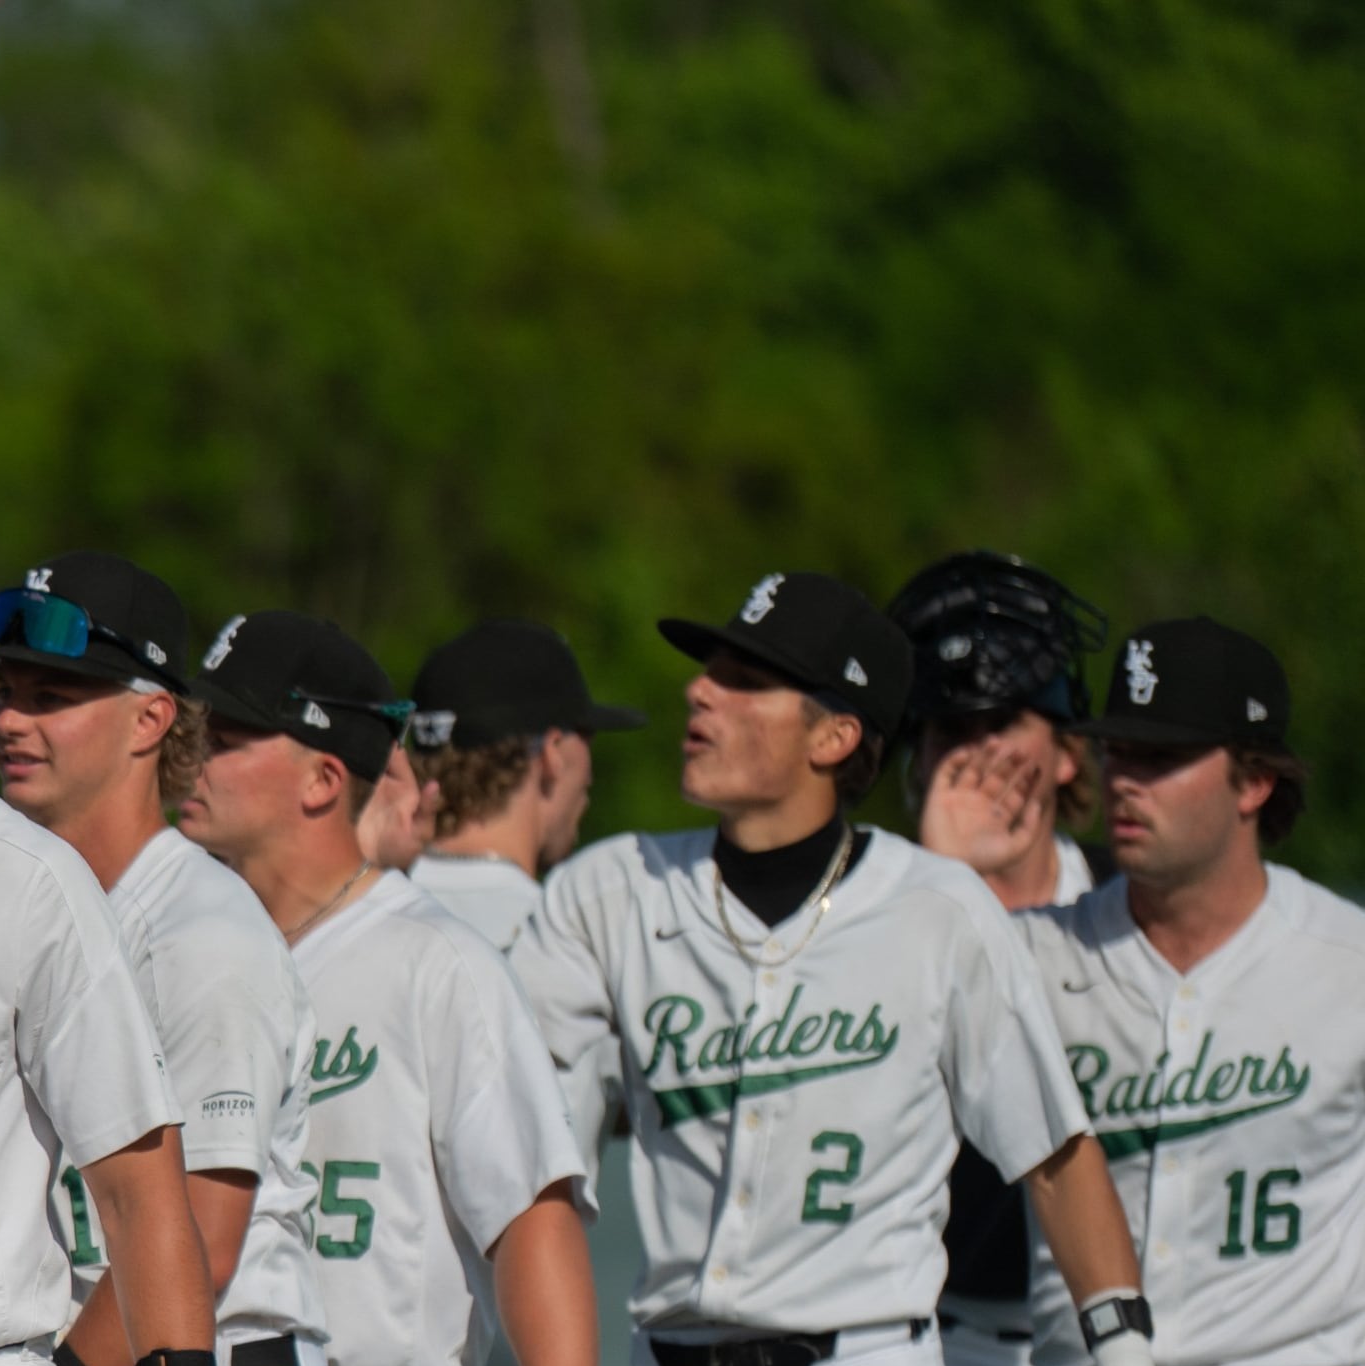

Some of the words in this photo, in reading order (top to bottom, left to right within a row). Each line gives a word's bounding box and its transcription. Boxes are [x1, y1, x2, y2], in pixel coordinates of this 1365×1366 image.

[643, 984, 899, 1077] Raiders
[202, 1099, 255, 1113] HORIZON
[801, 1131, 865, 1225] 2
[1219, 1168, 1302, 1259] 16
